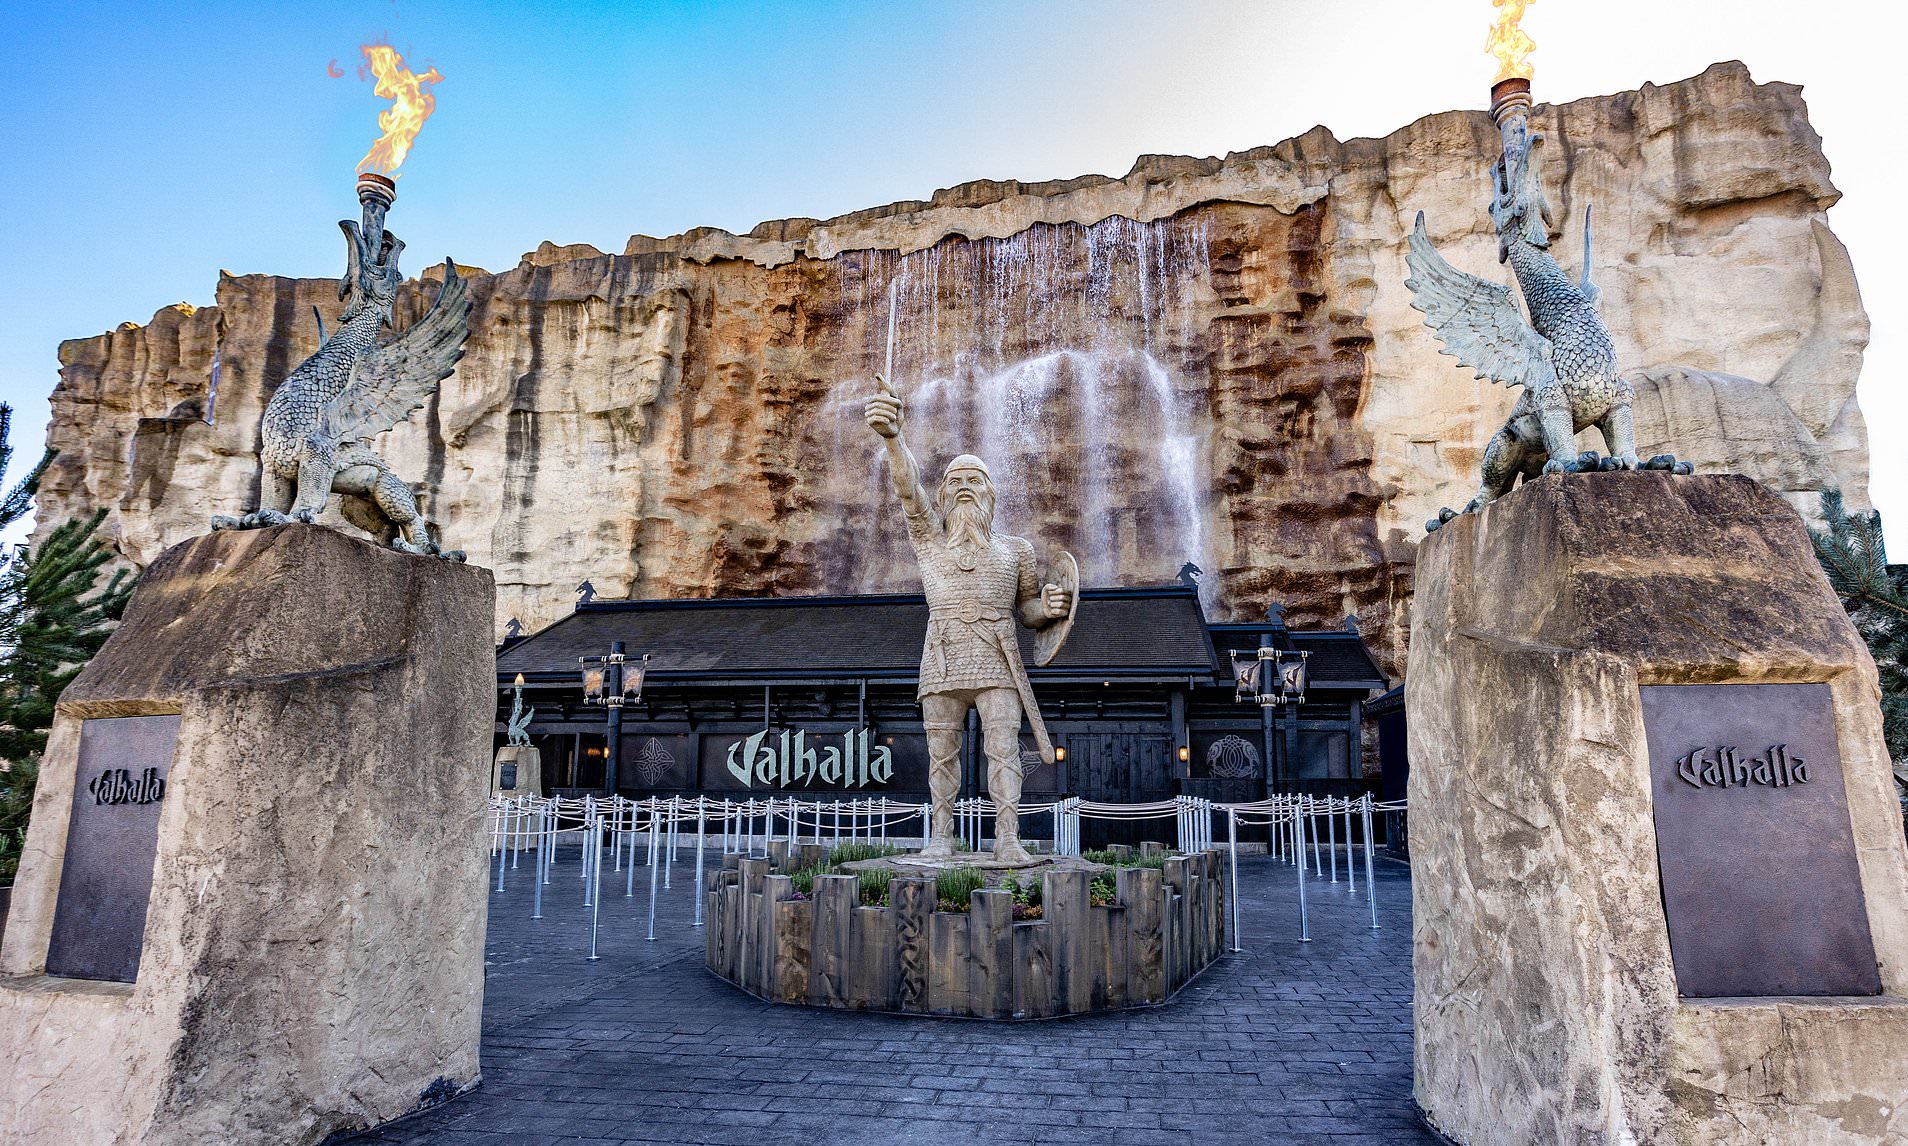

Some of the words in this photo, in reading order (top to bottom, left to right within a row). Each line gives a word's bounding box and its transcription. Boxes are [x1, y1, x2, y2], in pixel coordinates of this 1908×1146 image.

[726, 727, 895, 788] Valhalla
[1677, 744, 1812, 787] Valhalla
[89, 768, 164, 805] Valhalla
